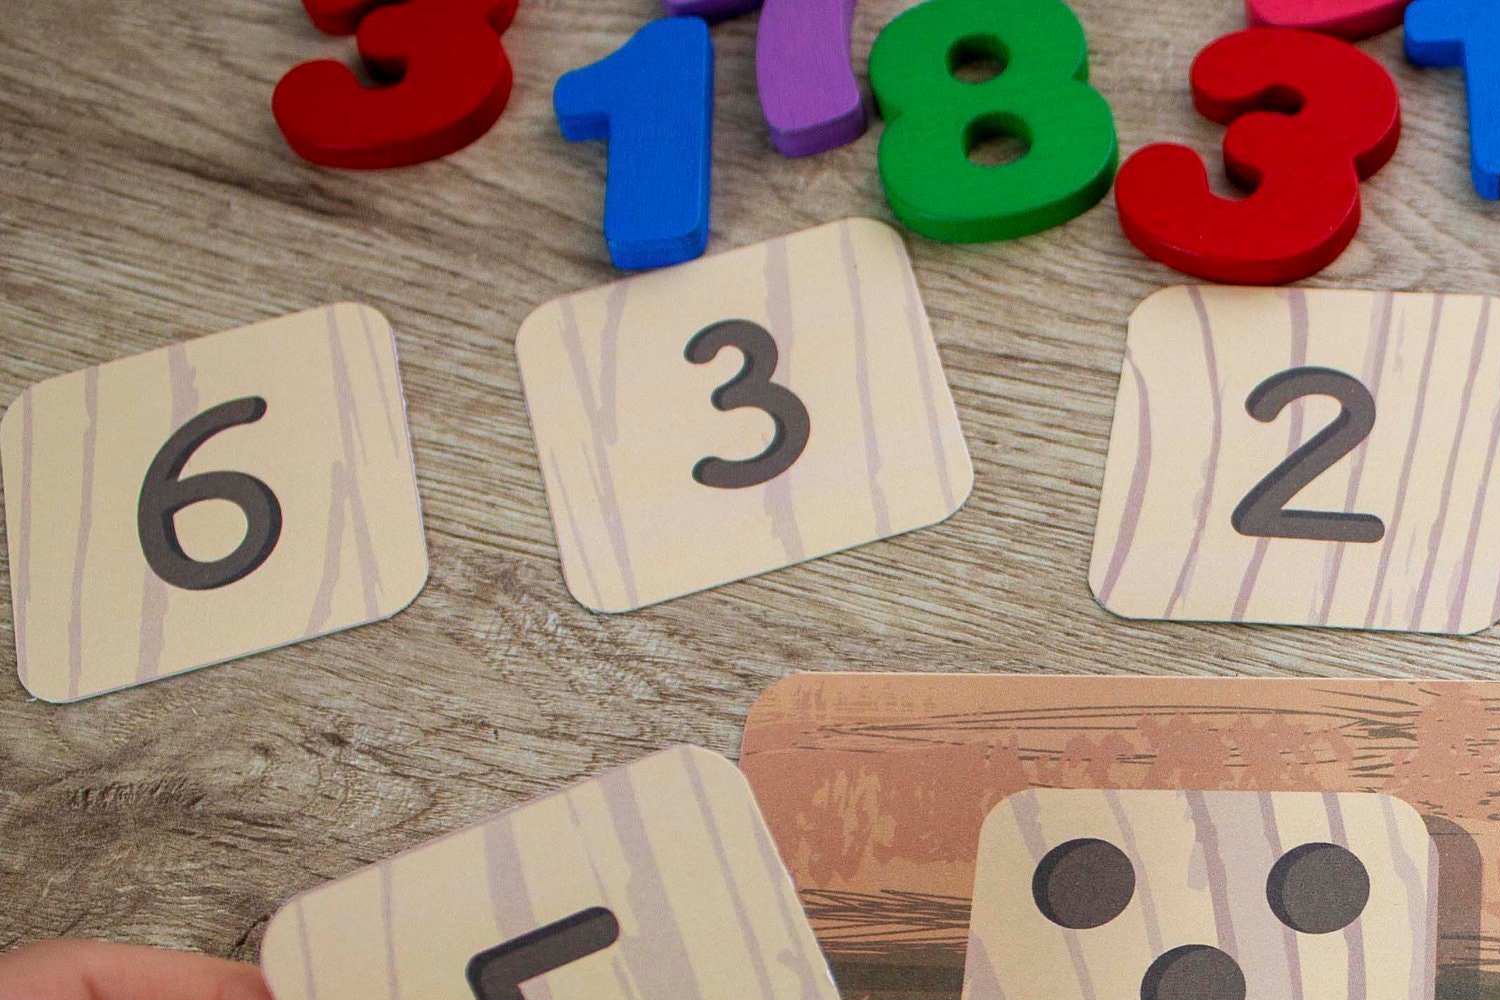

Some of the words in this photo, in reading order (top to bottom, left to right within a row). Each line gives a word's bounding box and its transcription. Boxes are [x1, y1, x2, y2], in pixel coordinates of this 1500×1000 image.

[553, 14, 714, 271] 1
[867, 0, 1119, 243] 8
[1114, 26, 1400, 286] 3
[138, 395, 284, 591] 6
[683, 319, 811, 489] 3
[1231, 366, 1385, 543] 2
